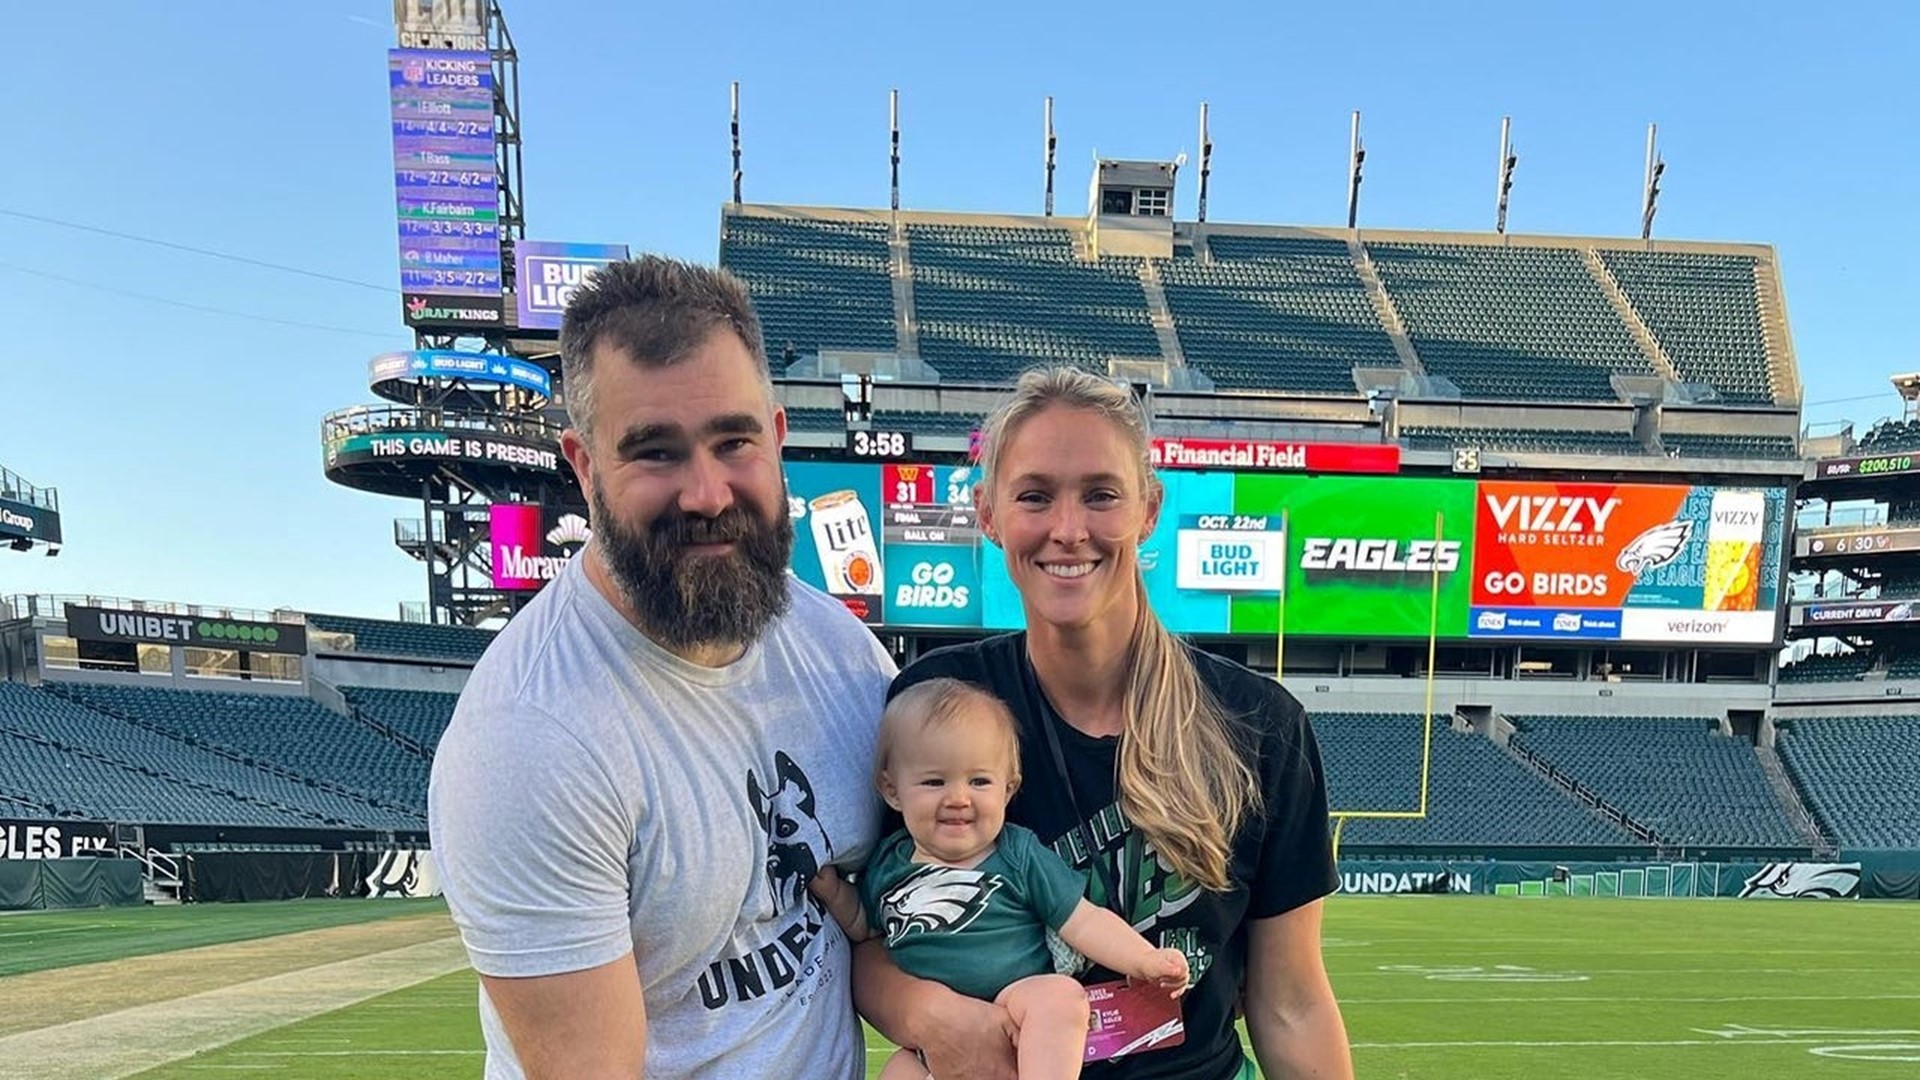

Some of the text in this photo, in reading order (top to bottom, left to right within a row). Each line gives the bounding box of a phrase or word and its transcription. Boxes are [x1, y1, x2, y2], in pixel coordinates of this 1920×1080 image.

[425, 60, 476, 72] KICKING
[426, 73, 480, 87] LEADERS
[532, 285, 578, 308] LIG
[411, 307, 499, 320] DRAFTKINGS
[434, 360, 485, 370] BUD LIGHT
[370, 439, 405, 456] THIS
[410, 438, 461, 456] GAME
[465, 440, 482, 458] IS
[854, 432, 905, 455] 3:58
[1164, 442, 1254, 465] Financial
[1256, 445, 1306, 467] Field
[896, 481, 916, 502] 31
[947, 483, 970, 504] 34
[2, 509, 34, 531] Group
[895, 512, 921, 523] FINAL
[1485, 495, 1618, 532] VIZZY
[1715, 511, 1759, 525] VIZZY
[1198, 516, 1267, 530] OCT. 22nd
[824, 515, 866, 551] Lite
[904, 530, 945, 541] BALL ON
[1498, 533, 1605, 546] HARD SELTZER
[1210, 544, 1252, 559] BUD
[1836, 537, 1872, 551] 6 30
[1300, 538, 1462, 572] EAGLES
[911, 562, 954, 586] GO
[1202, 560, 1259, 576] LIGHT
[1484, 571, 1607, 596] GO BIRDS
[896, 584, 969, 608] BIRDS
[1812, 608, 1882, 620] CURRENT DRIVE
[100, 613, 194, 640] UNIBET
[1667, 618, 1723, 633] verizon
